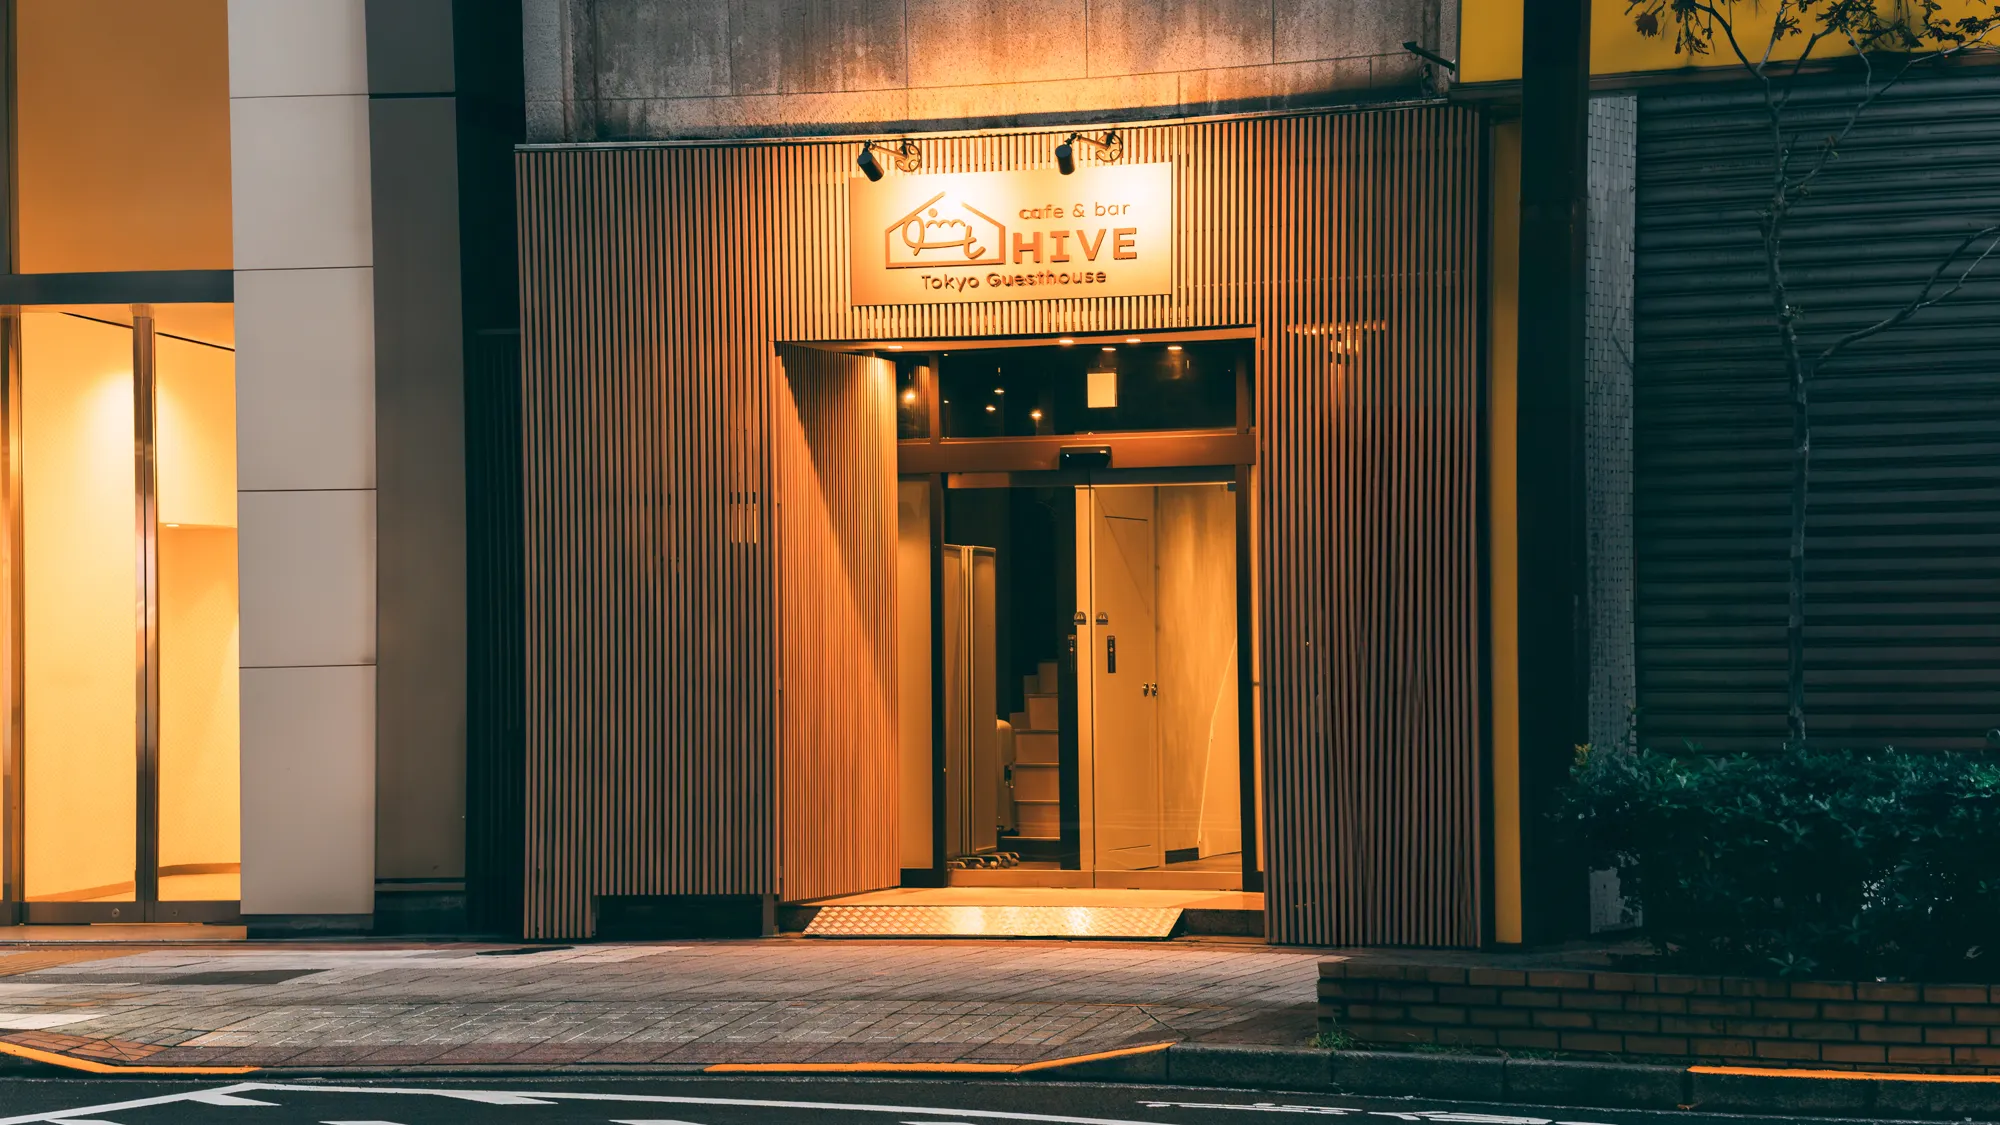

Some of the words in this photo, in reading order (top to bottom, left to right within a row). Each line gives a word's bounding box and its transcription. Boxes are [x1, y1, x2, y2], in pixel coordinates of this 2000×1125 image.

[1018, 204, 1064, 220] cafe
[1072, 203, 1085, 218] &
[1095, 201, 1131, 217] bar
[1012, 227, 1138, 264] HIVE
[921, 274, 980, 293] Tokyo
[986, 270, 1107, 288] Guesthouse
